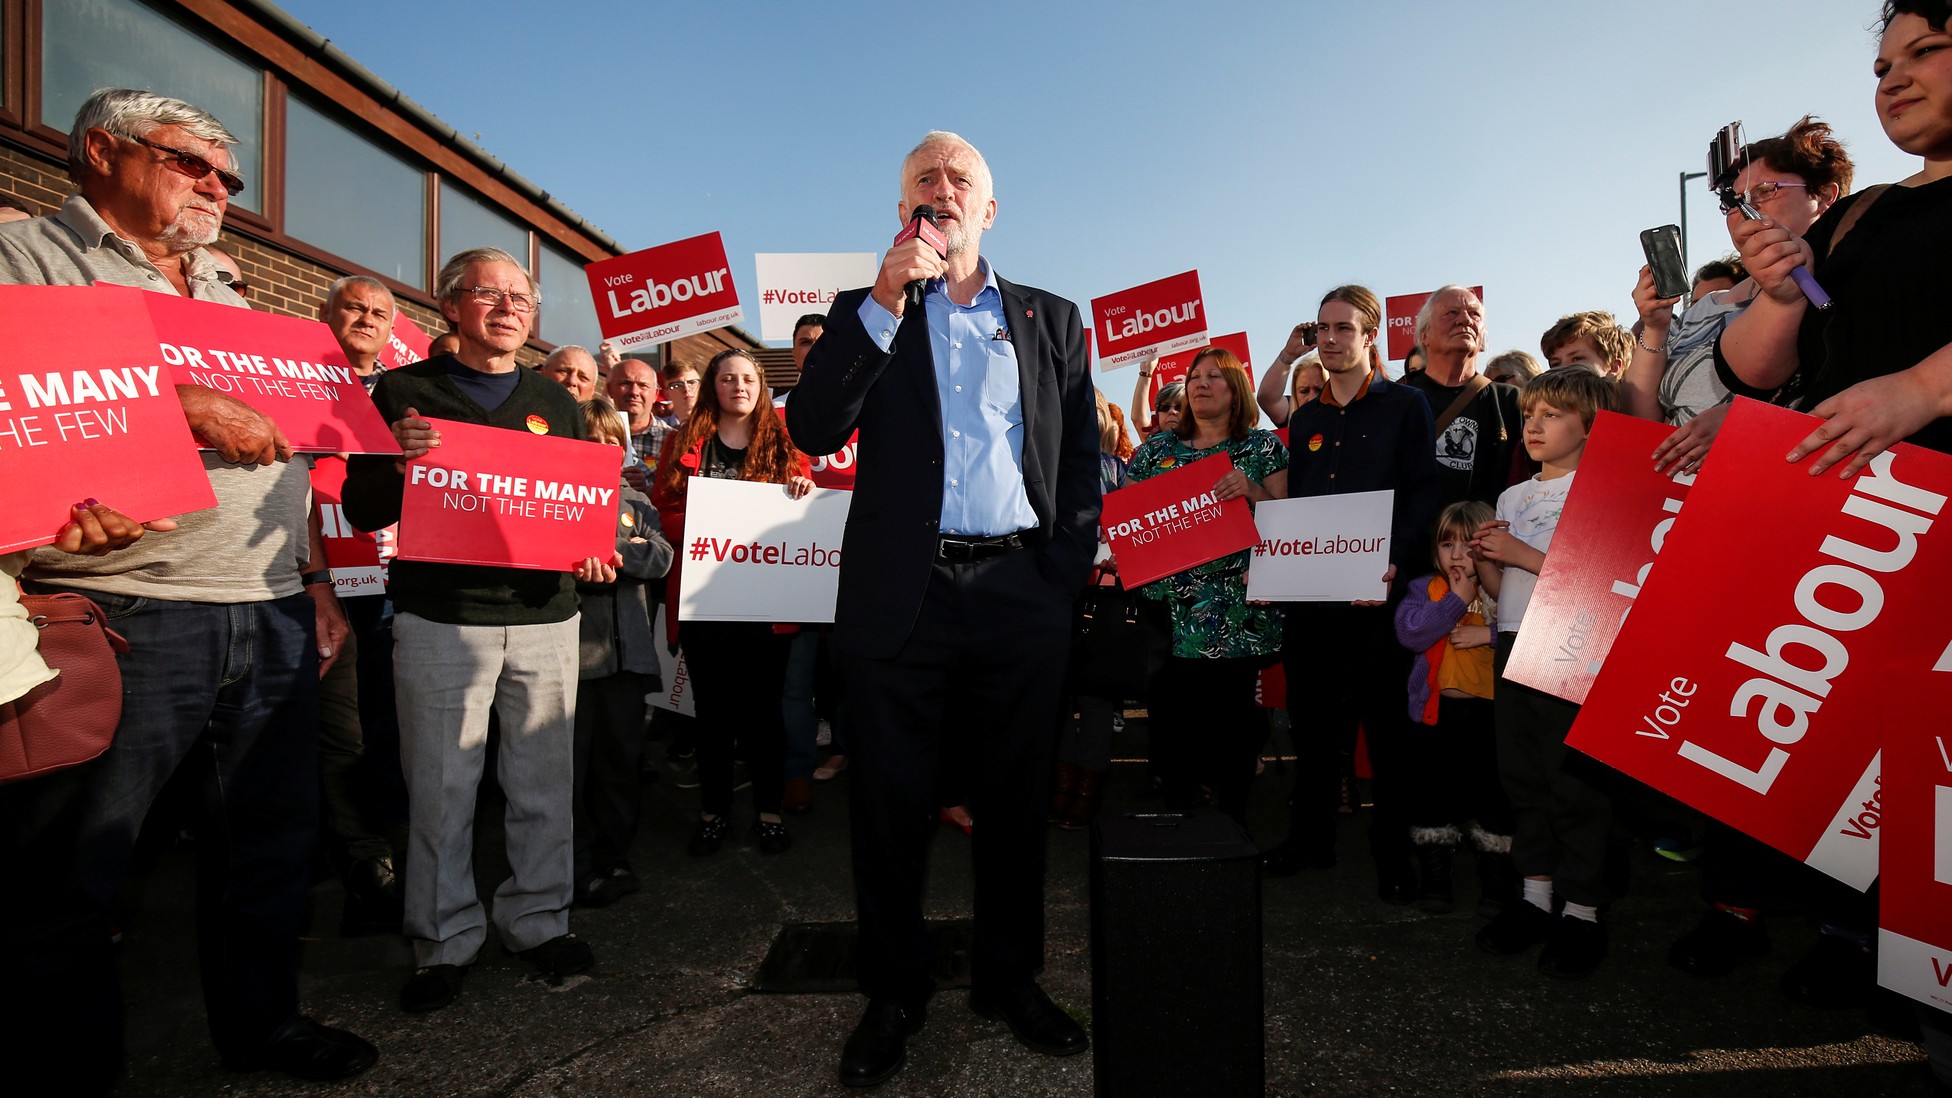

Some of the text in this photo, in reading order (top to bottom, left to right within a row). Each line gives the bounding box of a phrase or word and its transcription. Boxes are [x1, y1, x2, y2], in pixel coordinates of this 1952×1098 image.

[604, 273, 633, 288] Vote
[607, 267, 728, 319] Labour
[763, 288, 839, 304] #VoteLa
[1104, 305, 1126, 317] Vote
[1105, 299, 1200, 342] Labour
[1388, 316, 1413, 328] FOR
[1402, 326, 1417, 336] NO
[160, 343, 354, 385] OR THE MANY
[19, 366, 160, 408] MANY
[189, 370, 340, 402] NOT THE FEW
[0, 407, 128, 448] HE FEW
[411, 465, 614, 507] FOR THE MANY
[443, 492, 585, 522] NOT THE FEW
[1107, 489, 1219, 540] FOR THE MA
[1131, 504, 1223, 547] NOT THE FEW
[689, 537, 842, 567] #VoteLabo
[1254, 535, 1386, 557] #VoteLabour
[1554, 610, 1596, 662] Vote
[1677, 450, 1948, 796] Labour
[1635, 676, 1698, 740] Vote
